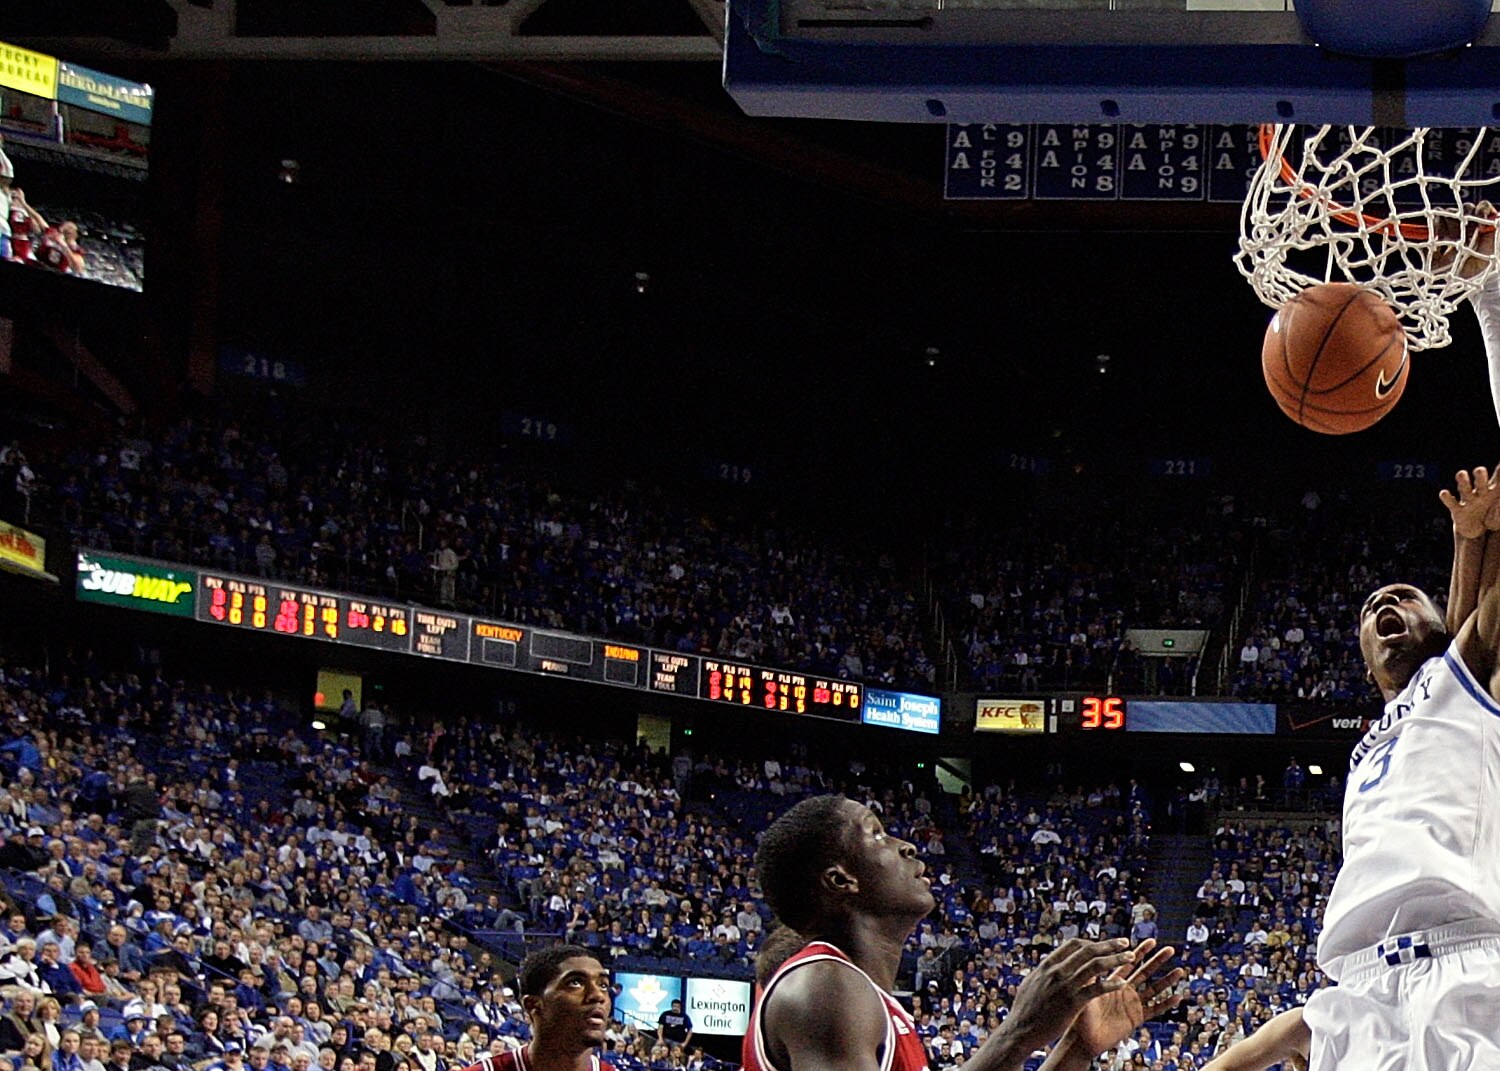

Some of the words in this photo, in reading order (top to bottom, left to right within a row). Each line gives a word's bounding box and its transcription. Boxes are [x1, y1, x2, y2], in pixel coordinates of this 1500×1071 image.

[0, 47, 39, 67] UCKY
[82, 568, 192, 603] SUBWAY
[476, 624, 523, 642] KENTUCKY
[605, 645, 639, 661] INDIANA
[794, 686, 806, 700] 10
[867, 693, 896, 707] Saint
[897, 697, 938, 716] Joseph
[981, 706, 1016, 719] KFC
[1082, 697, 1123, 729] 35
[867, 707, 900, 723] Health
[902, 711, 938, 730] System
[1359, 736, 1398, 793] 3
[691, 997, 746, 1014] Lexington
[704, 1015, 732, 1028] Clinic
